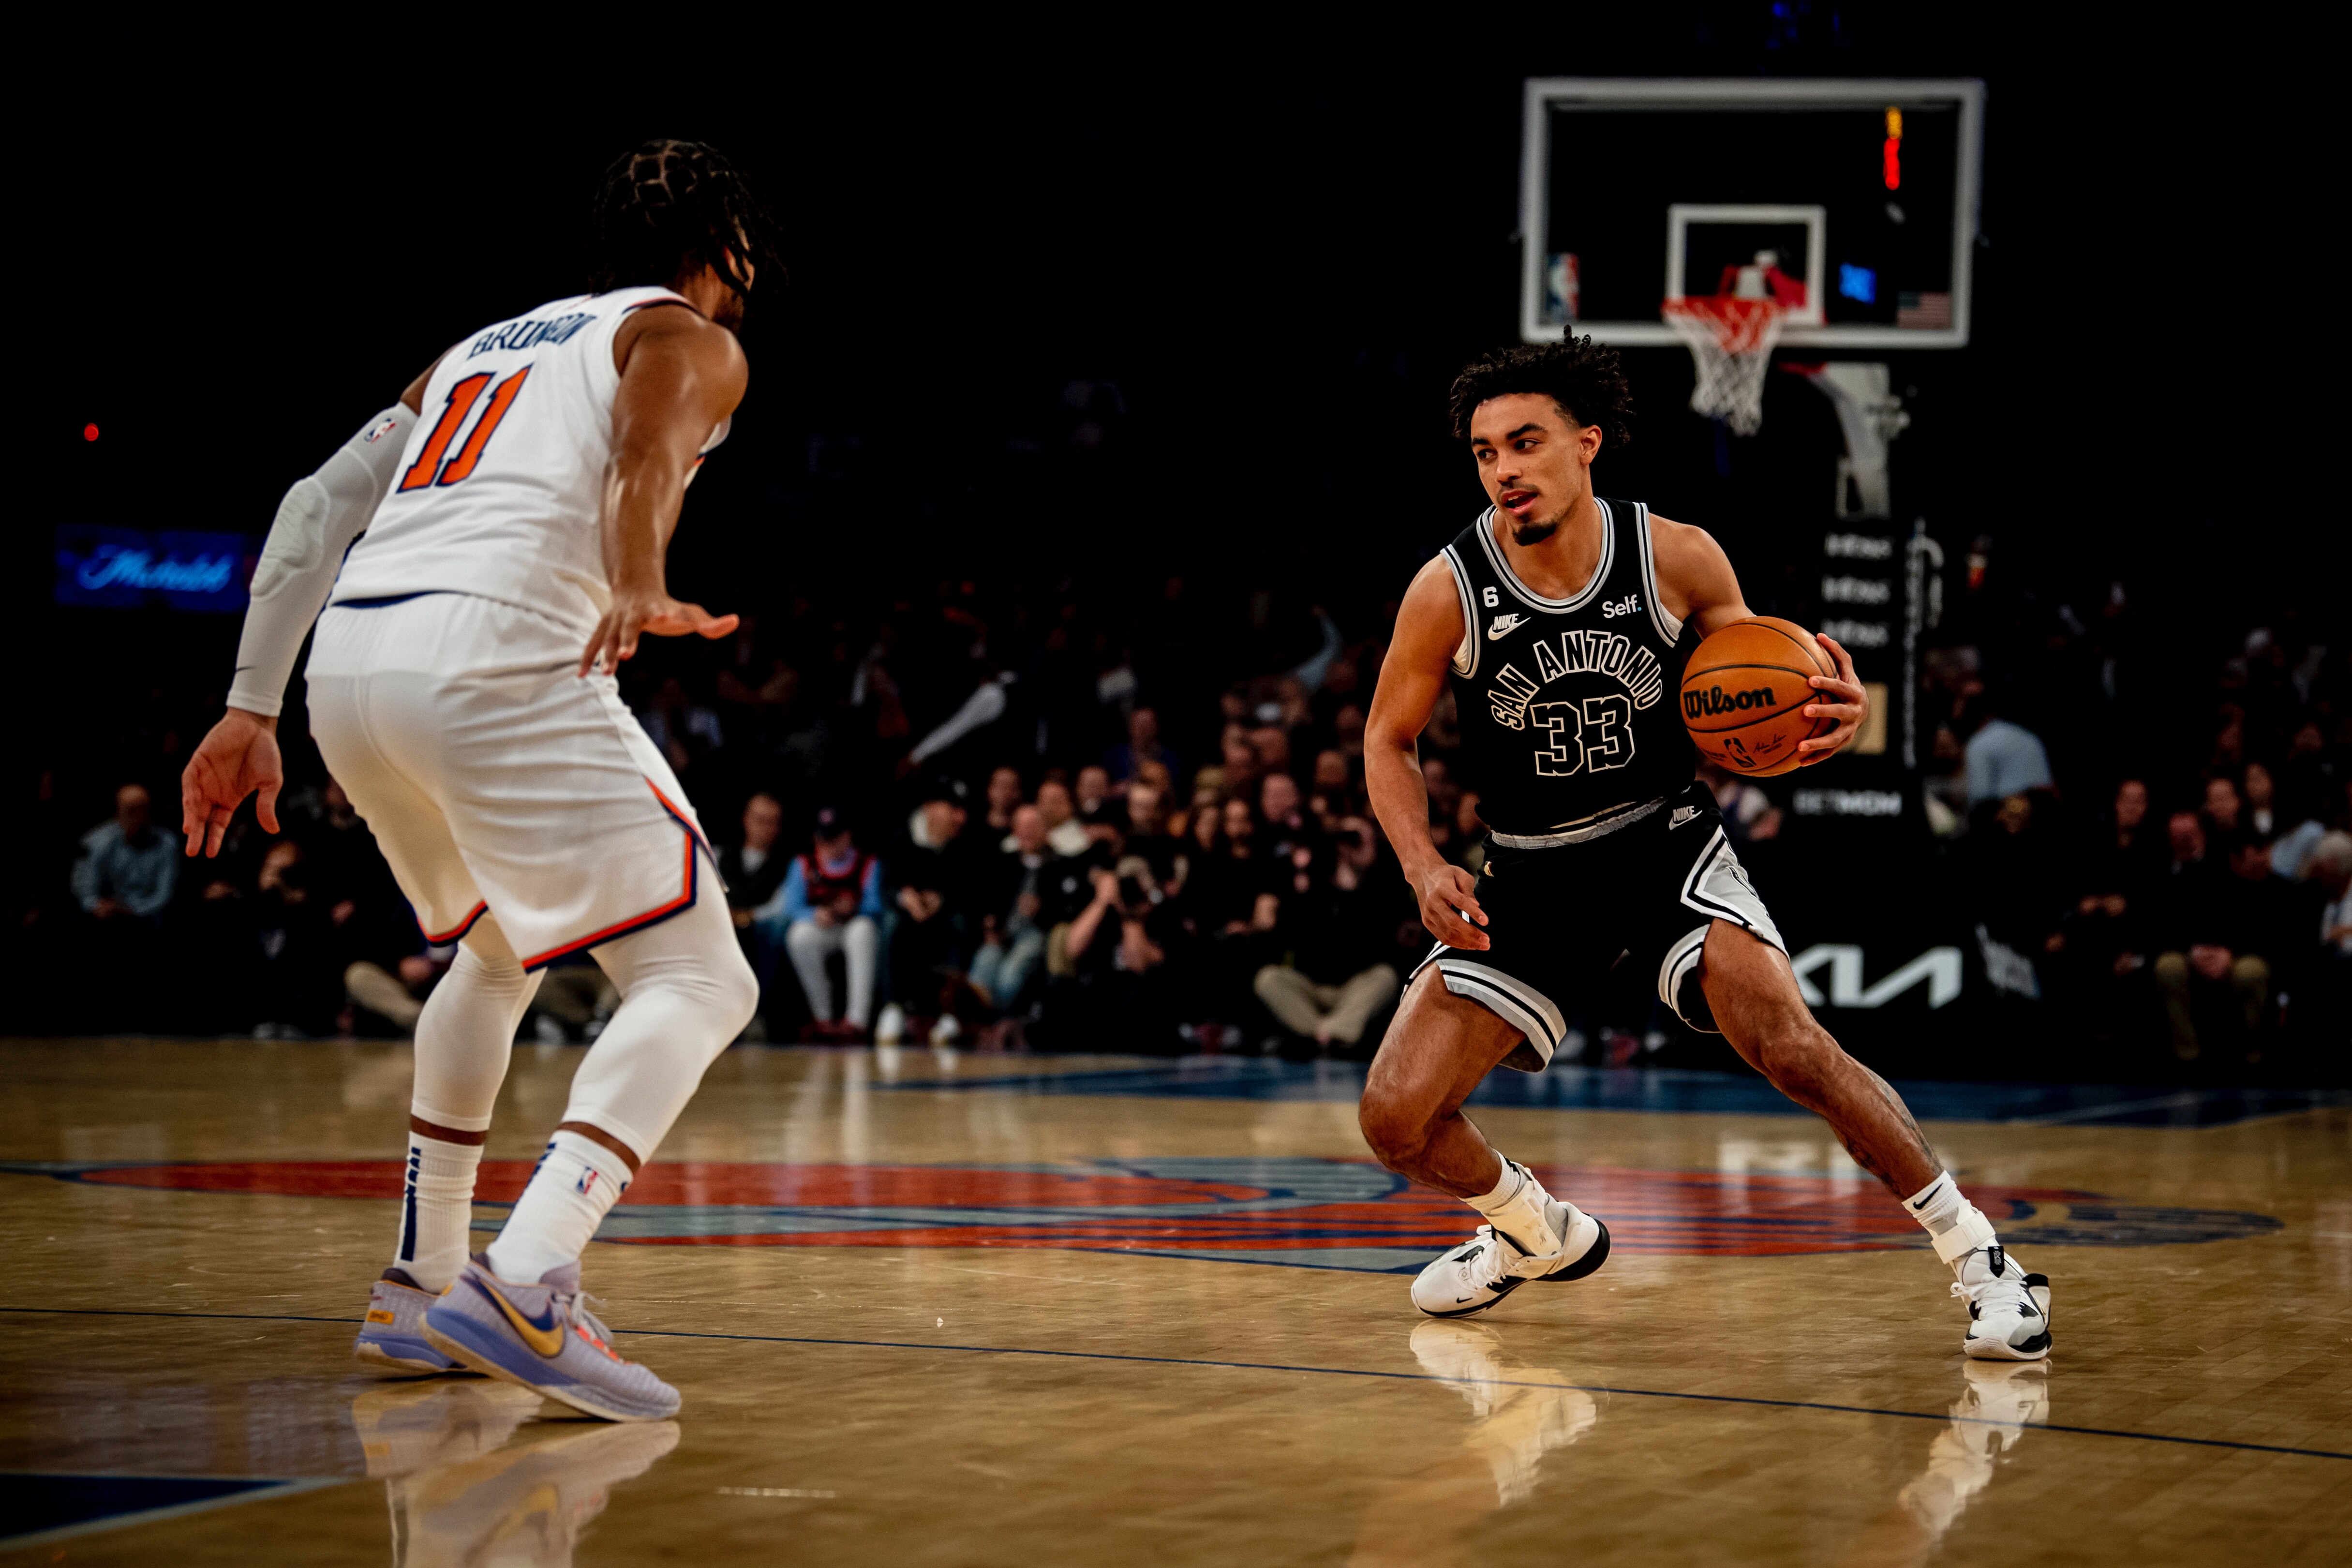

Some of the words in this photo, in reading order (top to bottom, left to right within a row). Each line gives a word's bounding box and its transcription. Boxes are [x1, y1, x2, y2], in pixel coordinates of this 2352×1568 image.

[395, 361, 535, 494] 11
[1483, 586, 1499, 608] 6
[1493, 613, 1519, 630] NIKE
[1488, 662, 1540, 731] SAN
[1532, 629, 1663, 710] ANTONIO
[1683, 685, 1777, 720] Wilson
[1530, 693, 1636, 777] 33
[1672, 806, 1695, 822] NIKE
